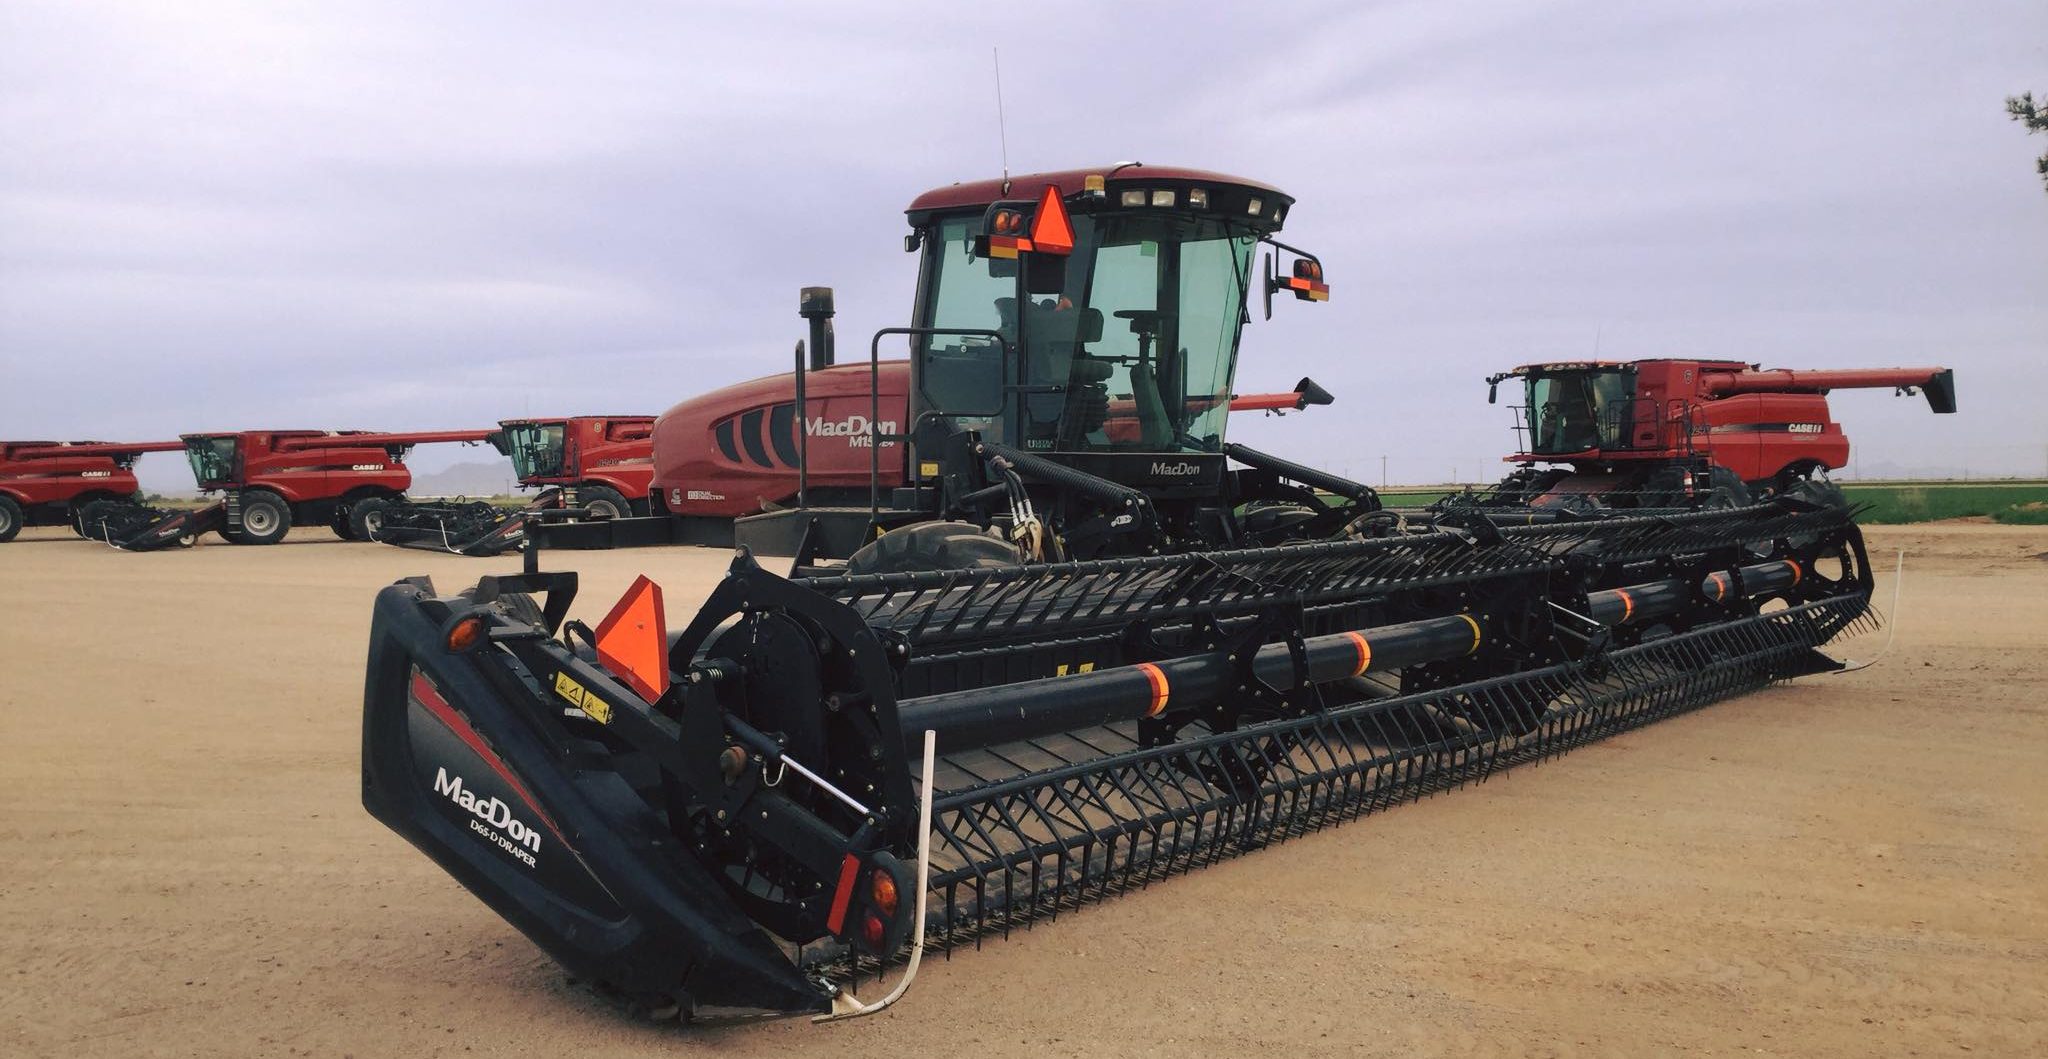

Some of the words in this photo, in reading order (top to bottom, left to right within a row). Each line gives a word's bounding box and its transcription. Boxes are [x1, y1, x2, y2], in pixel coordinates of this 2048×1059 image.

[805, 415, 897, 437] MacDon
[1150, 462, 1200, 475] MacDon
[434, 766, 541, 853] MacDon
[498, 836, 536, 868] DRAPER
